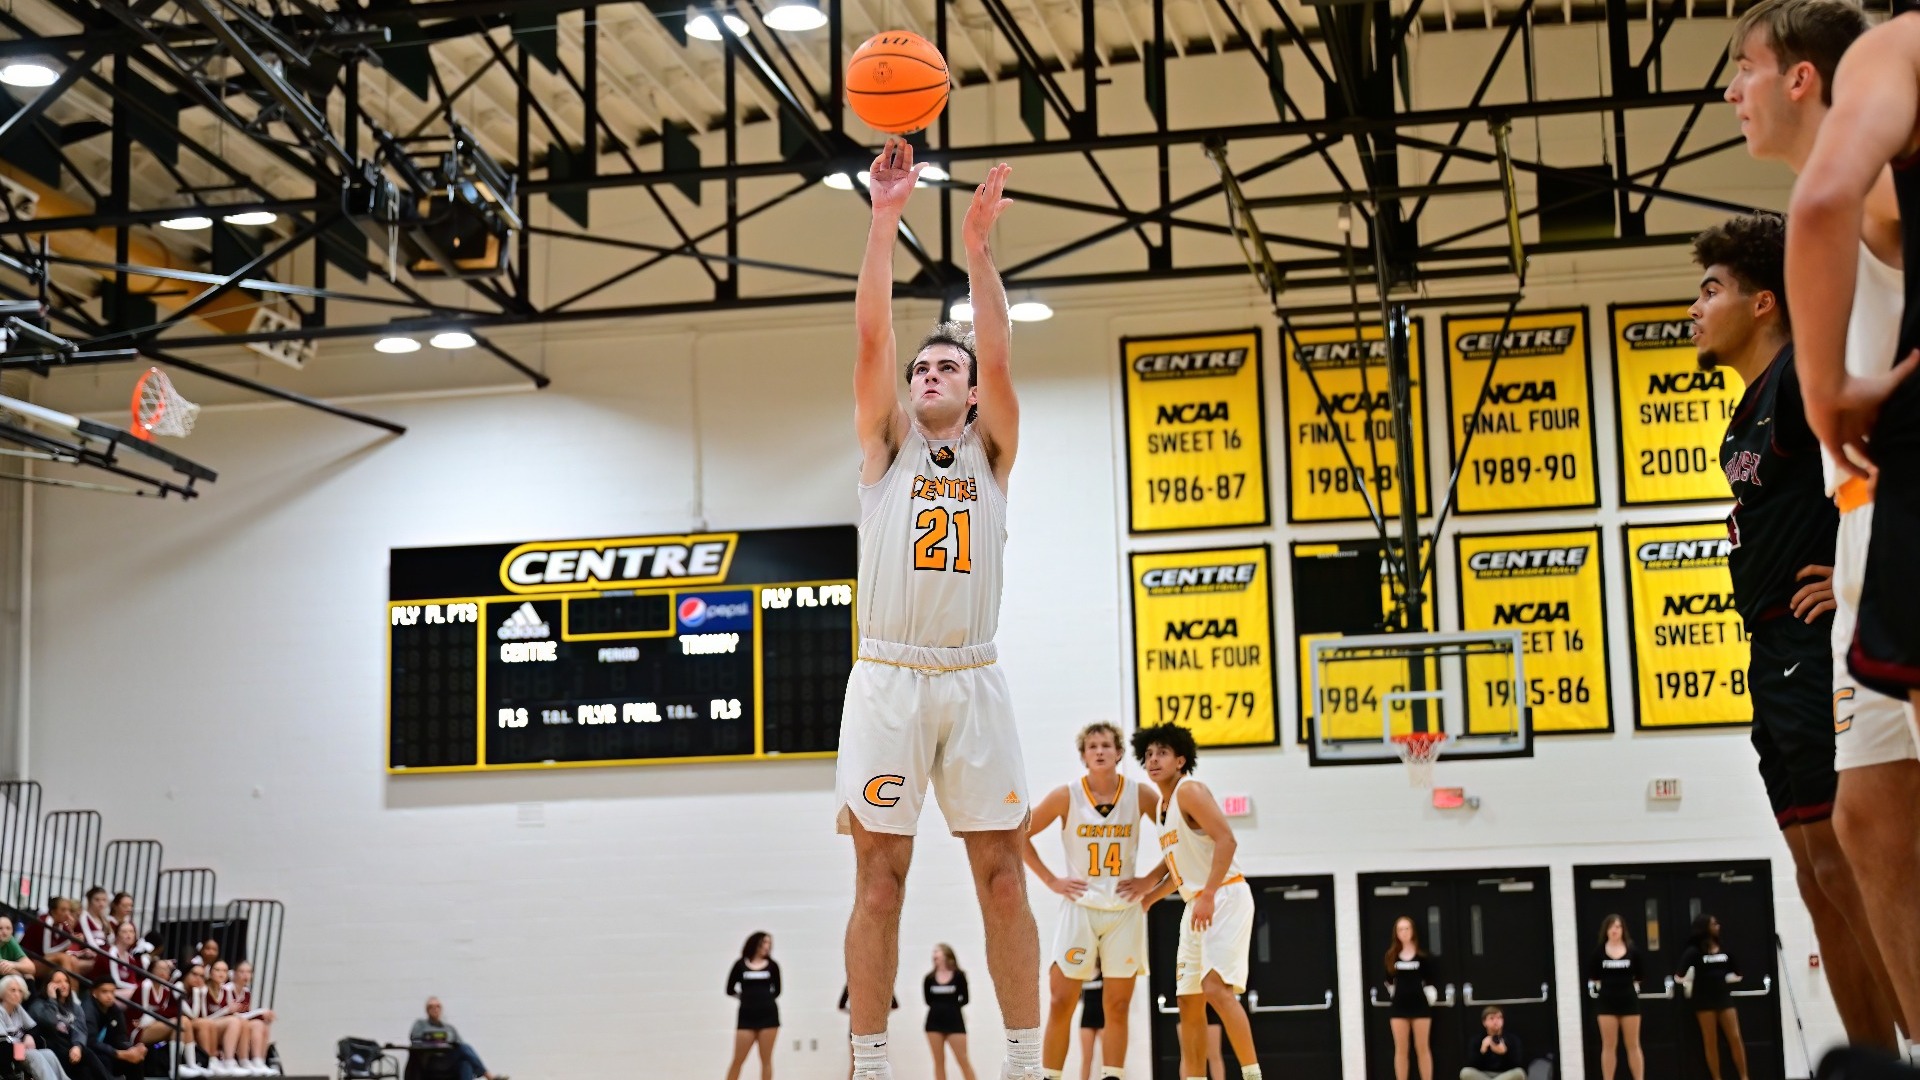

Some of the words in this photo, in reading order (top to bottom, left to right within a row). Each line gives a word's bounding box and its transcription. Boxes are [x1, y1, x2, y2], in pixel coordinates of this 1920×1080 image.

[1459, 328, 1570, 351] CENTRE
[1626, 320, 1696, 341] CENT
[1135, 349, 1244, 373] CENTRE
[1295, 340, 1388, 361] CENTR
[1483, 381, 1556, 405] NCAA
[1648, 371, 1725, 394] NCAA
[1157, 402, 1229, 424] NCAA
[1316, 391, 1390, 415] NCAA
[1640, 400, 1710, 424] SWEET
[1529, 407, 1580, 431] FOUR
[1148, 430, 1213, 454] SWEET
[1224, 429, 1241, 450] 16
[1472, 454, 1576, 486] 1989-90
[1641, 447, 1717, 476] 2000-
[911, 475, 977, 502] CENTRE
[1148, 473, 1246, 504] 1986-87
[1308, 465, 1399, 494] 1988-8
[914, 506, 971, 574] 21
[1639, 540, 1732, 561] CENTR
[508, 542, 726, 584] CENTRE
[1470, 547, 1585, 570] CENTRE
[1142, 564, 1254, 588] CENTRE
[819, 585, 852, 606] PTS
[1663, 593, 1735, 616] NCAA
[447, 603, 477, 623] PTS
[706, 602, 749, 619] pepsi
[1493, 601, 1570, 625] NCAA
[1165, 618, 1238, 641] NCAA
[1564, 629, 1583, 652] 16
[1655, 622, 1725, 647] SWEET
[500, 641, 558, 663] CENTRE
[598, 647, 640, 662] PERIOD
[1146, 649, 1203, 671] FINAL
[1211, 645, 1261, 668] FOUR
[1655, 669, 1745, 699] 1987-8
[710, 699, 742, 720] FLS
[1156, 692, 1255, 722] 1978-79
[1319, 685, 1405, 714] 19848
[498, 708, 528, 728] FLS
[863, 774, 905, 807] C
[1656, 779, 1677, 796] EXIT
[1076, 823, 1133, 838] CENTRE
[1088, 842, 1122, 877] 14
[1065, 947, 1086, 965] C
